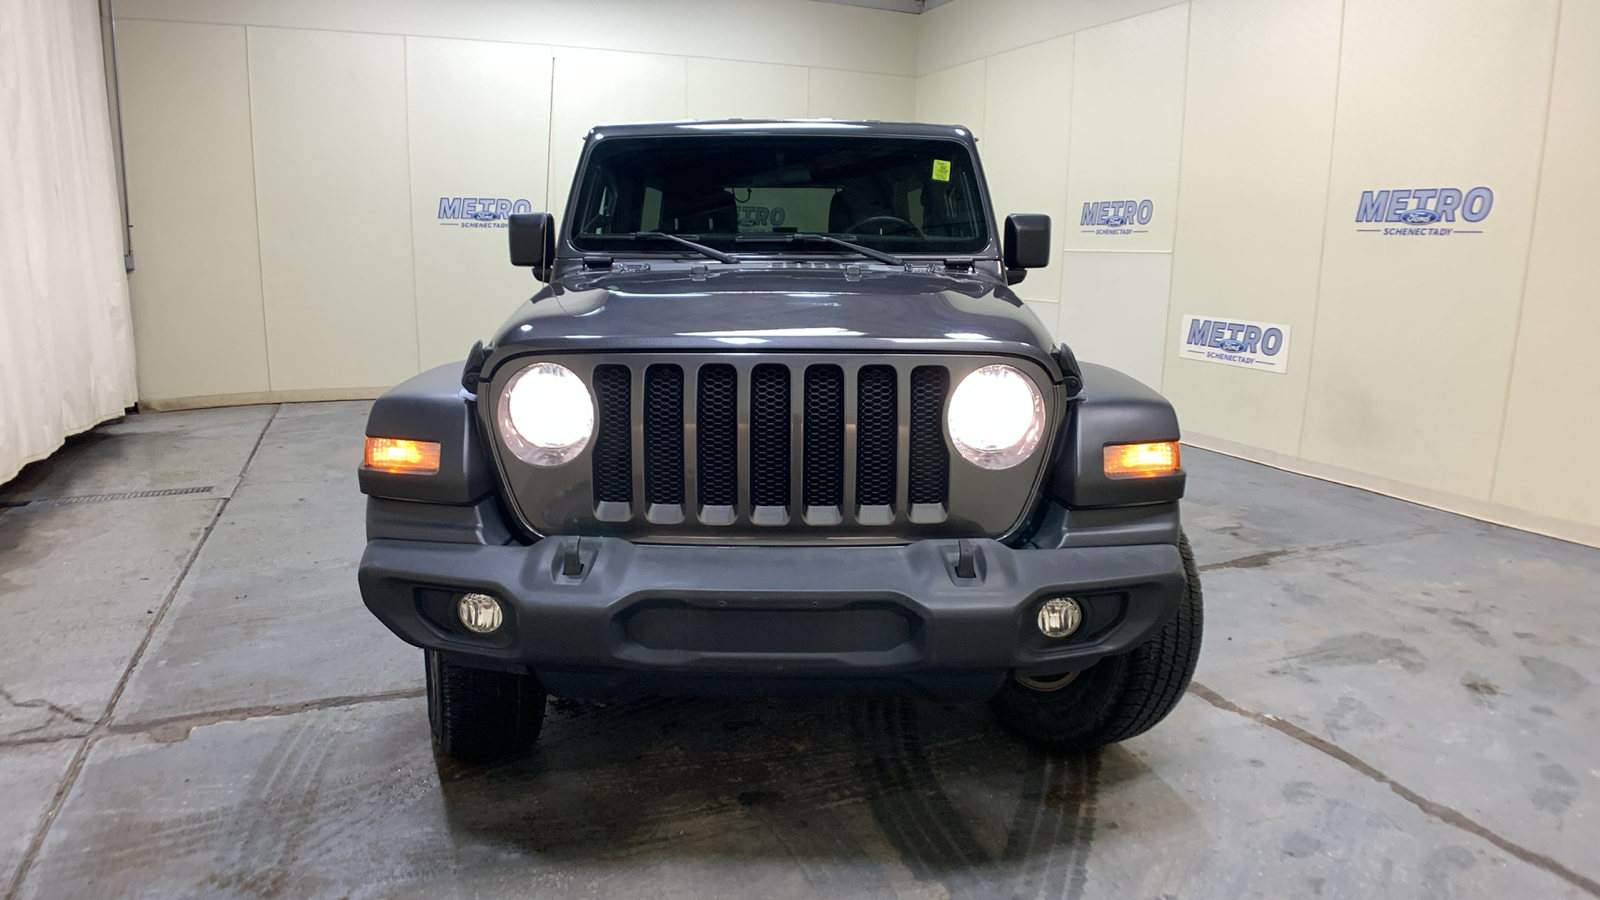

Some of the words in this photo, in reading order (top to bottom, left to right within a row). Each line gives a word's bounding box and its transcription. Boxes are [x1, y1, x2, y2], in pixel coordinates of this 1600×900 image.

[437, 197, 532, 219] METRO
[1080, 199, 1154, 226] METRO
[1355, 186, 1494, 223] METRO
[1382, 227, 1453, 236] SCHENECTADY
[1186, 318, 1284, 357] METRO
[1206, 351, 1256, 365] SCHENECTADY
